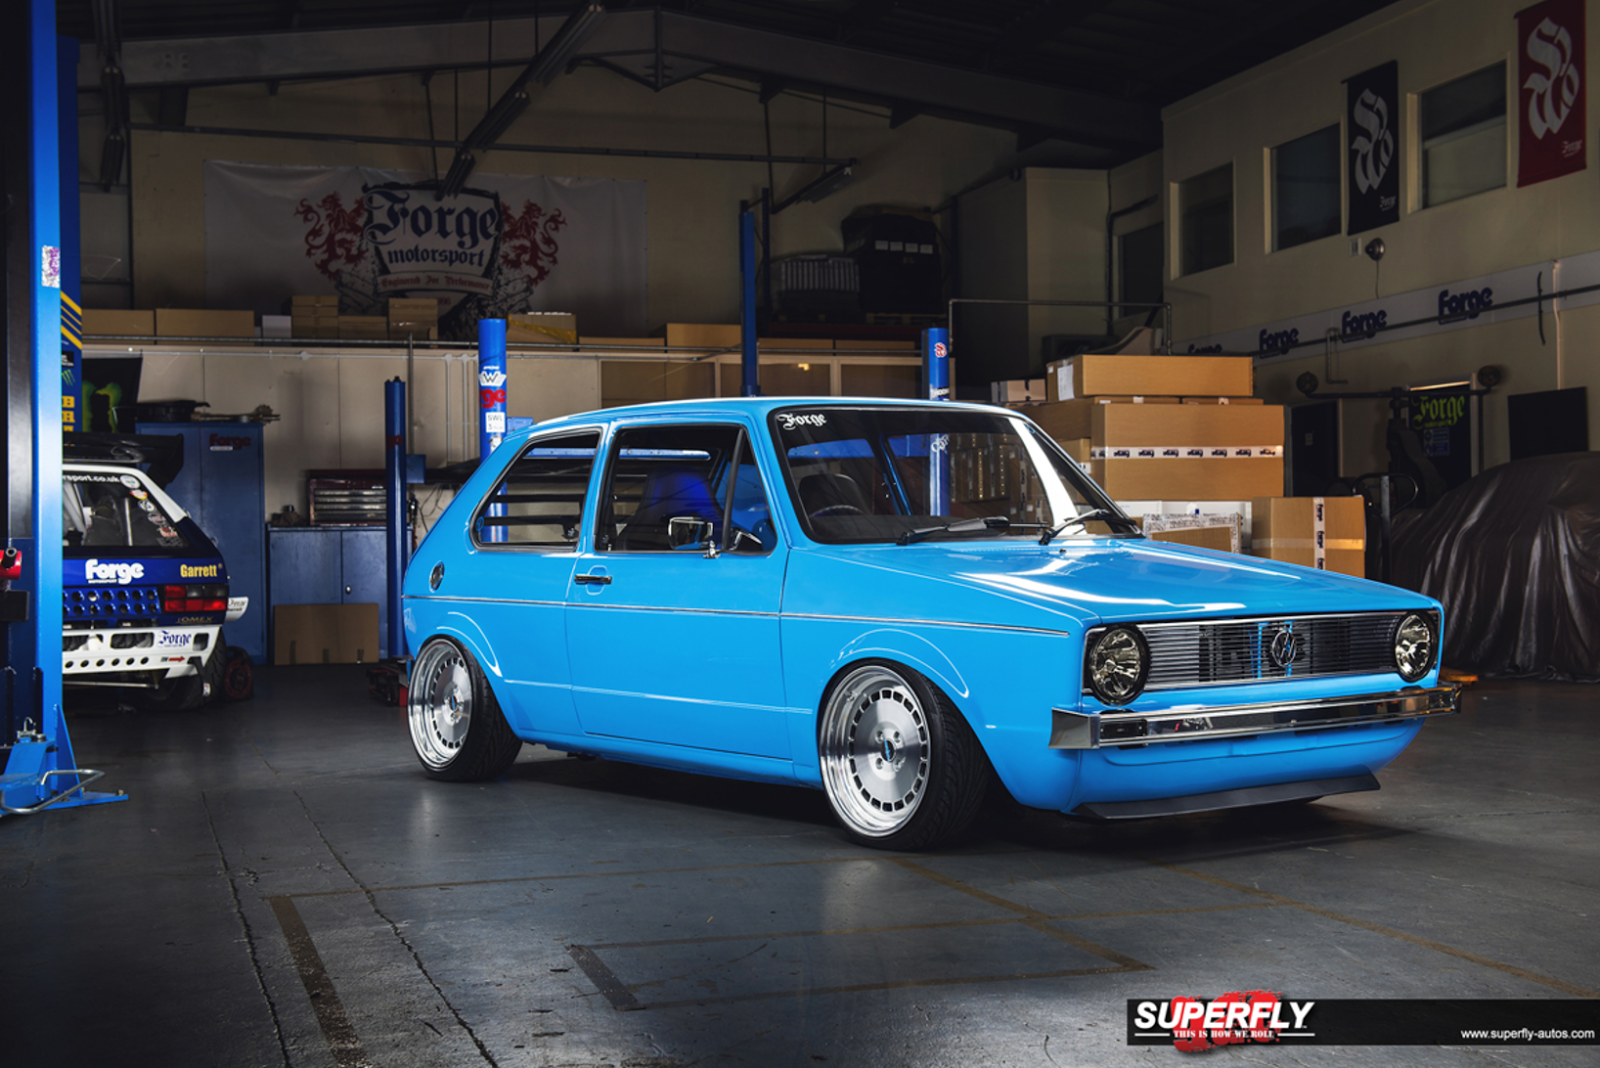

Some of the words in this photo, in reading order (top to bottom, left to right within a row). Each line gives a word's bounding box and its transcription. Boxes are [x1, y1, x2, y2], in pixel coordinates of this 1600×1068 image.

[365, 190, 498, 250] Forge
[387, 245, 485, 268] motorsport
[777, 412, 828, 431] Forge
[1411, 395, 1466, 430] Forge
[180, 563, 218, 578] Garrett
[157, 630, 192, 648] Forge
